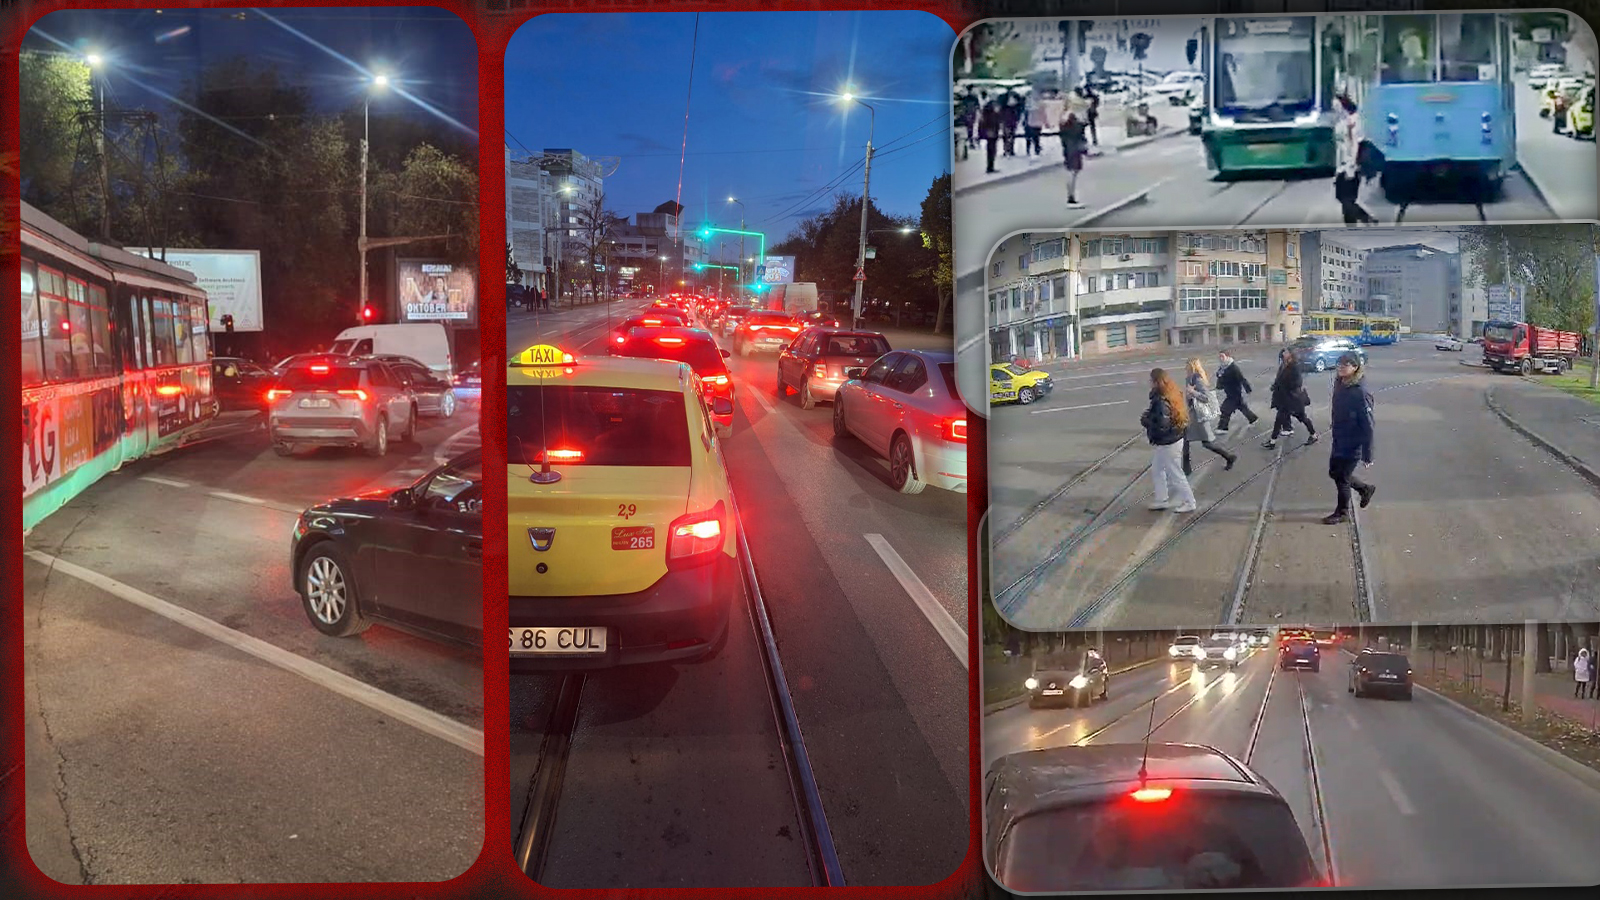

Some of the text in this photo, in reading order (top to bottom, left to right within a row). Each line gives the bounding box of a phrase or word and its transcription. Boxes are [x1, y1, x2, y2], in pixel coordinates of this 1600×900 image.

[530, 348, 554, 363] TAXI
[618, 503, 637, 520] 2,9
[630, 536, 653, 549] 265
[521, 629, 547, 649] 86
[557, 628, 599, 649] CUL
